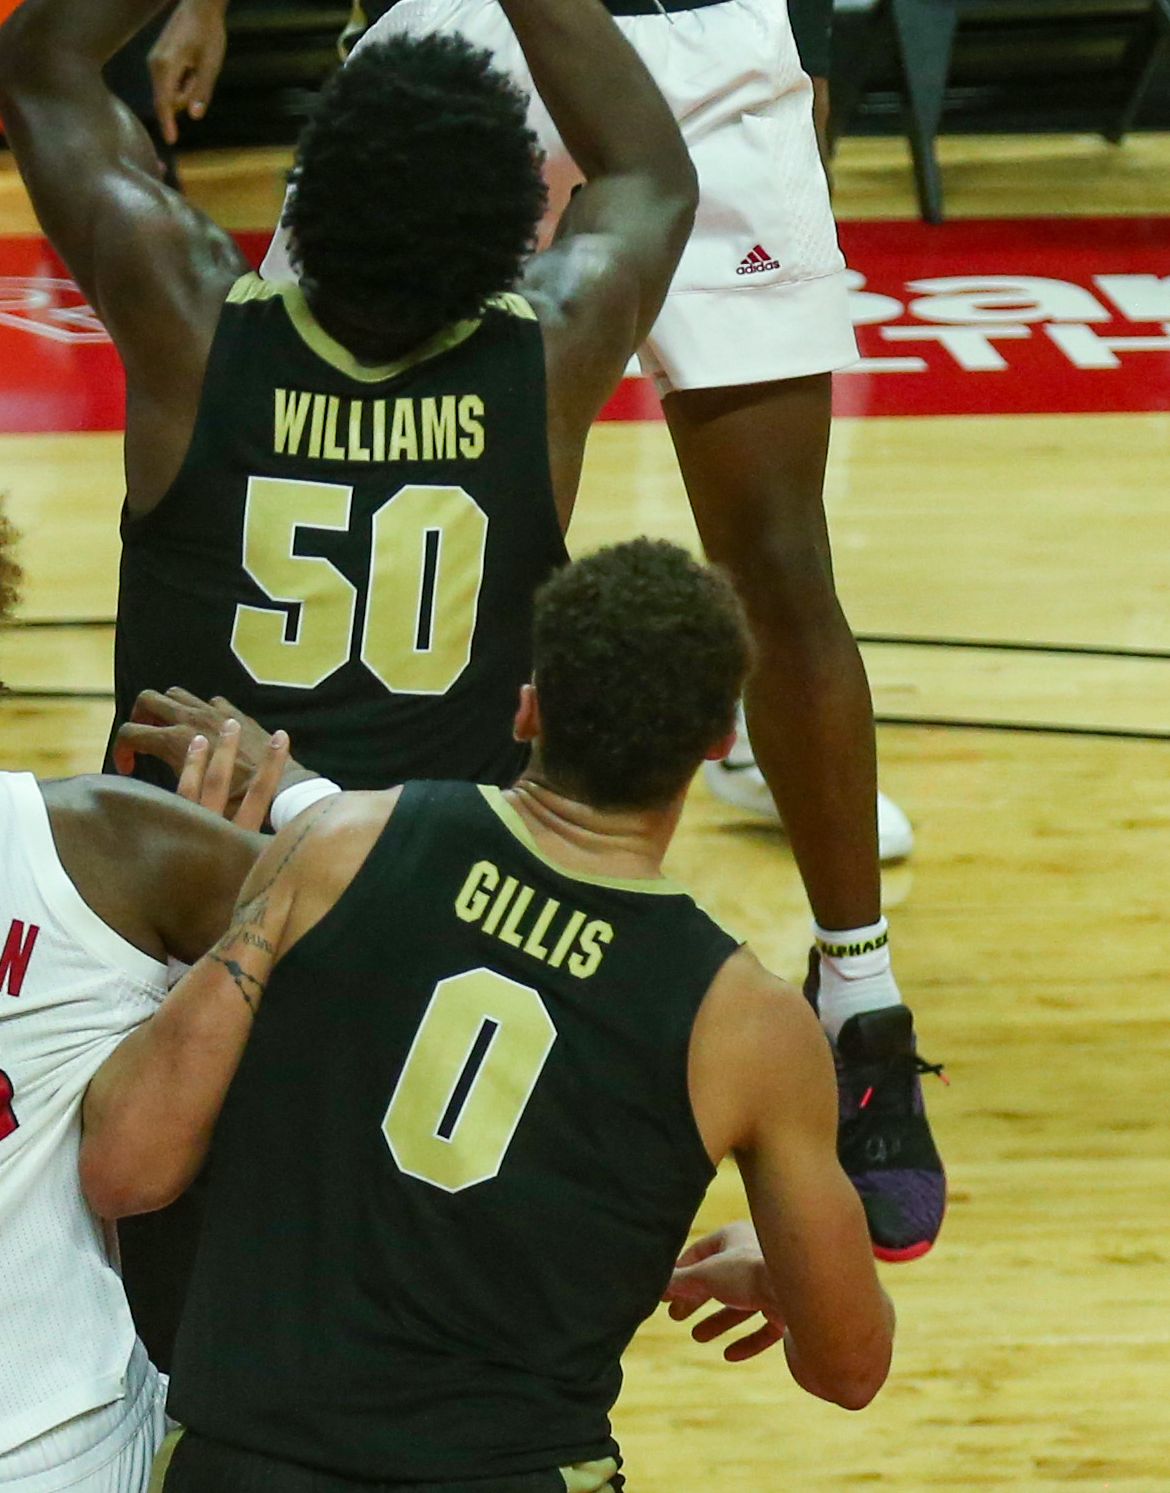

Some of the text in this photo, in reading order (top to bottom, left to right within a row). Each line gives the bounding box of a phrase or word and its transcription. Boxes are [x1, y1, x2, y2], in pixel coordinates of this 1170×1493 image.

[736, 260, 780, 275] adidas
[274, 388, 485, 461] WILLIAMS
[230, 475, 489, 695] 50
[455, 860, 615, 979] GILLIS
[381, 966, 559, 1194] 0
